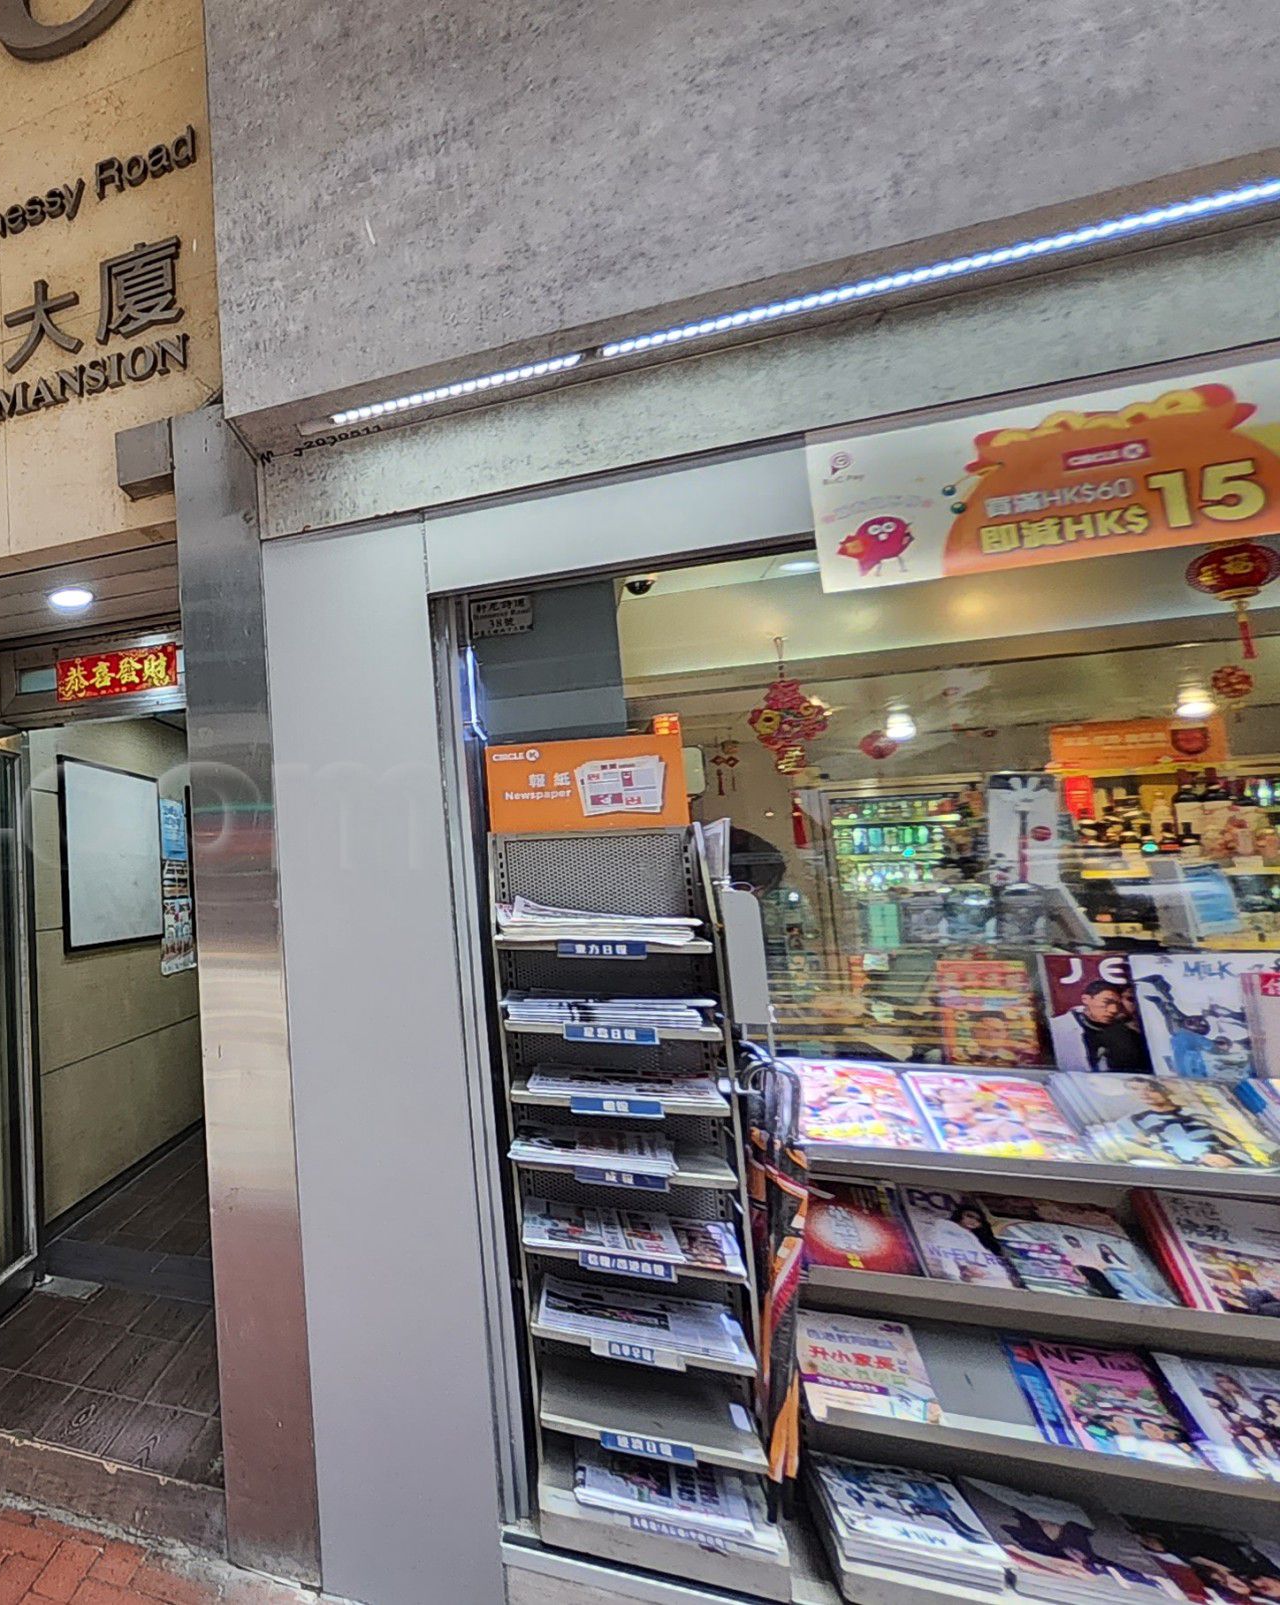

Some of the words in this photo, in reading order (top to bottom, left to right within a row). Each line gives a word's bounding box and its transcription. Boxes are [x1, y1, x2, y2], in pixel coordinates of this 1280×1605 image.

[95, 125, 197, 200] Road
[65, 652, 169, 692] 恭喜發財
[505, 789, 572, 801] Newspaper
